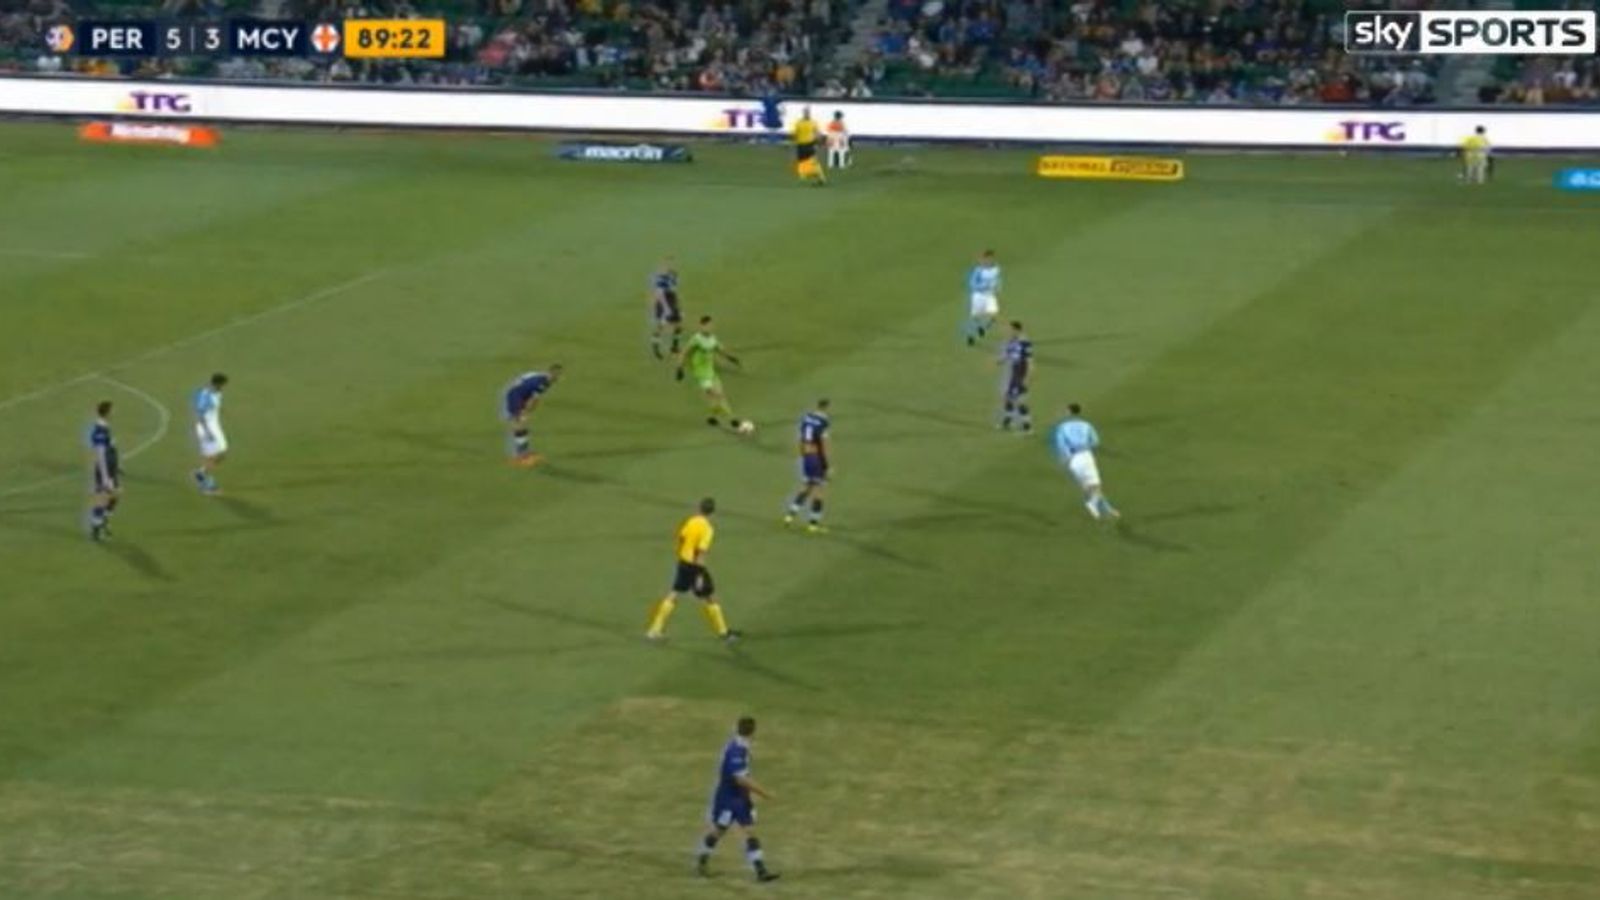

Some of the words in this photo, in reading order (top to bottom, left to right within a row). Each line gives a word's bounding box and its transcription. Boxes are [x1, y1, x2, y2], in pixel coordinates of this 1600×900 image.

[130, 91, 191, 112] TPG
[722, 109, 783, 128] TP
[1340, 121, 1405, 141] TPG
